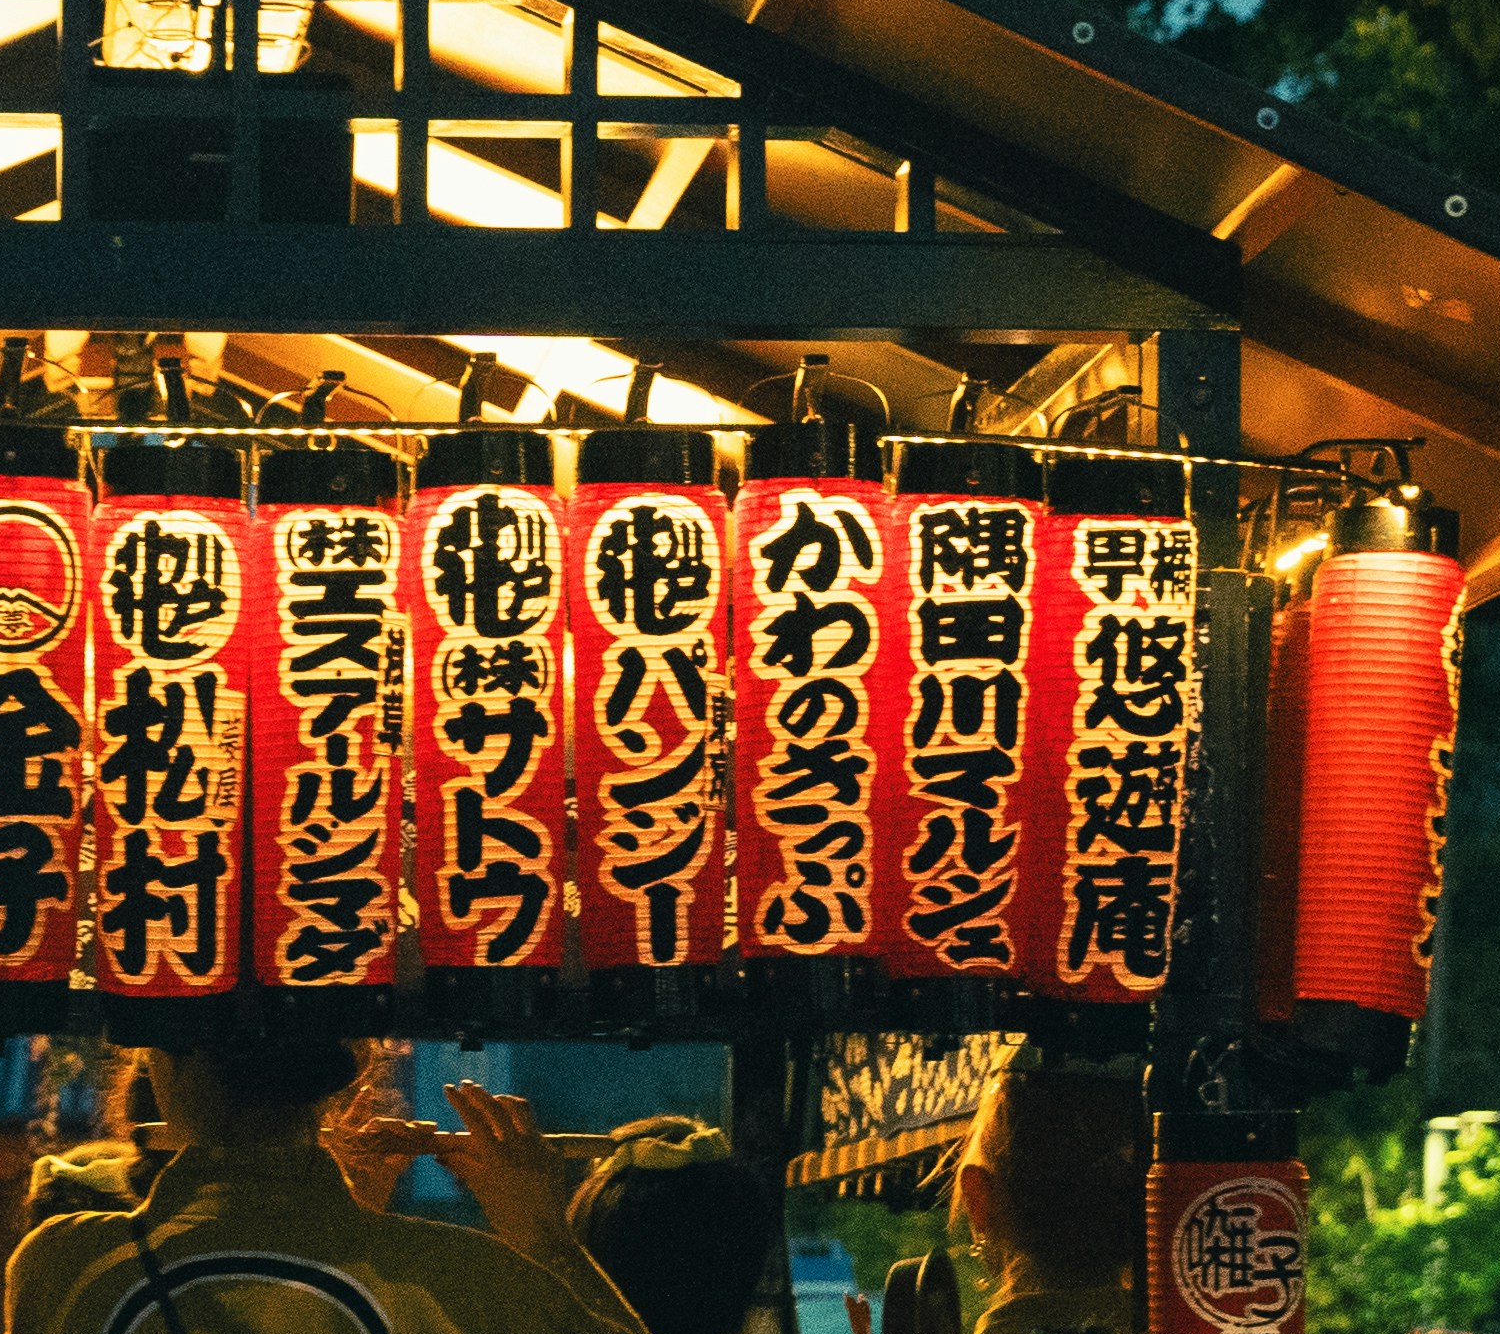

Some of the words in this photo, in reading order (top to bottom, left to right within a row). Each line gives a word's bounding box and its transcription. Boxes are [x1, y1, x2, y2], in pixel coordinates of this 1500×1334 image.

[100, 667, 227, 976] 松村
[604, 637, 711, 964] パンジー
[760, 502, 876, 945] かわのきっぷ
[908, 506, 1026, 965] 隅田川マルシェ
[1076, 614, 1187, 980] 悠遊庵
